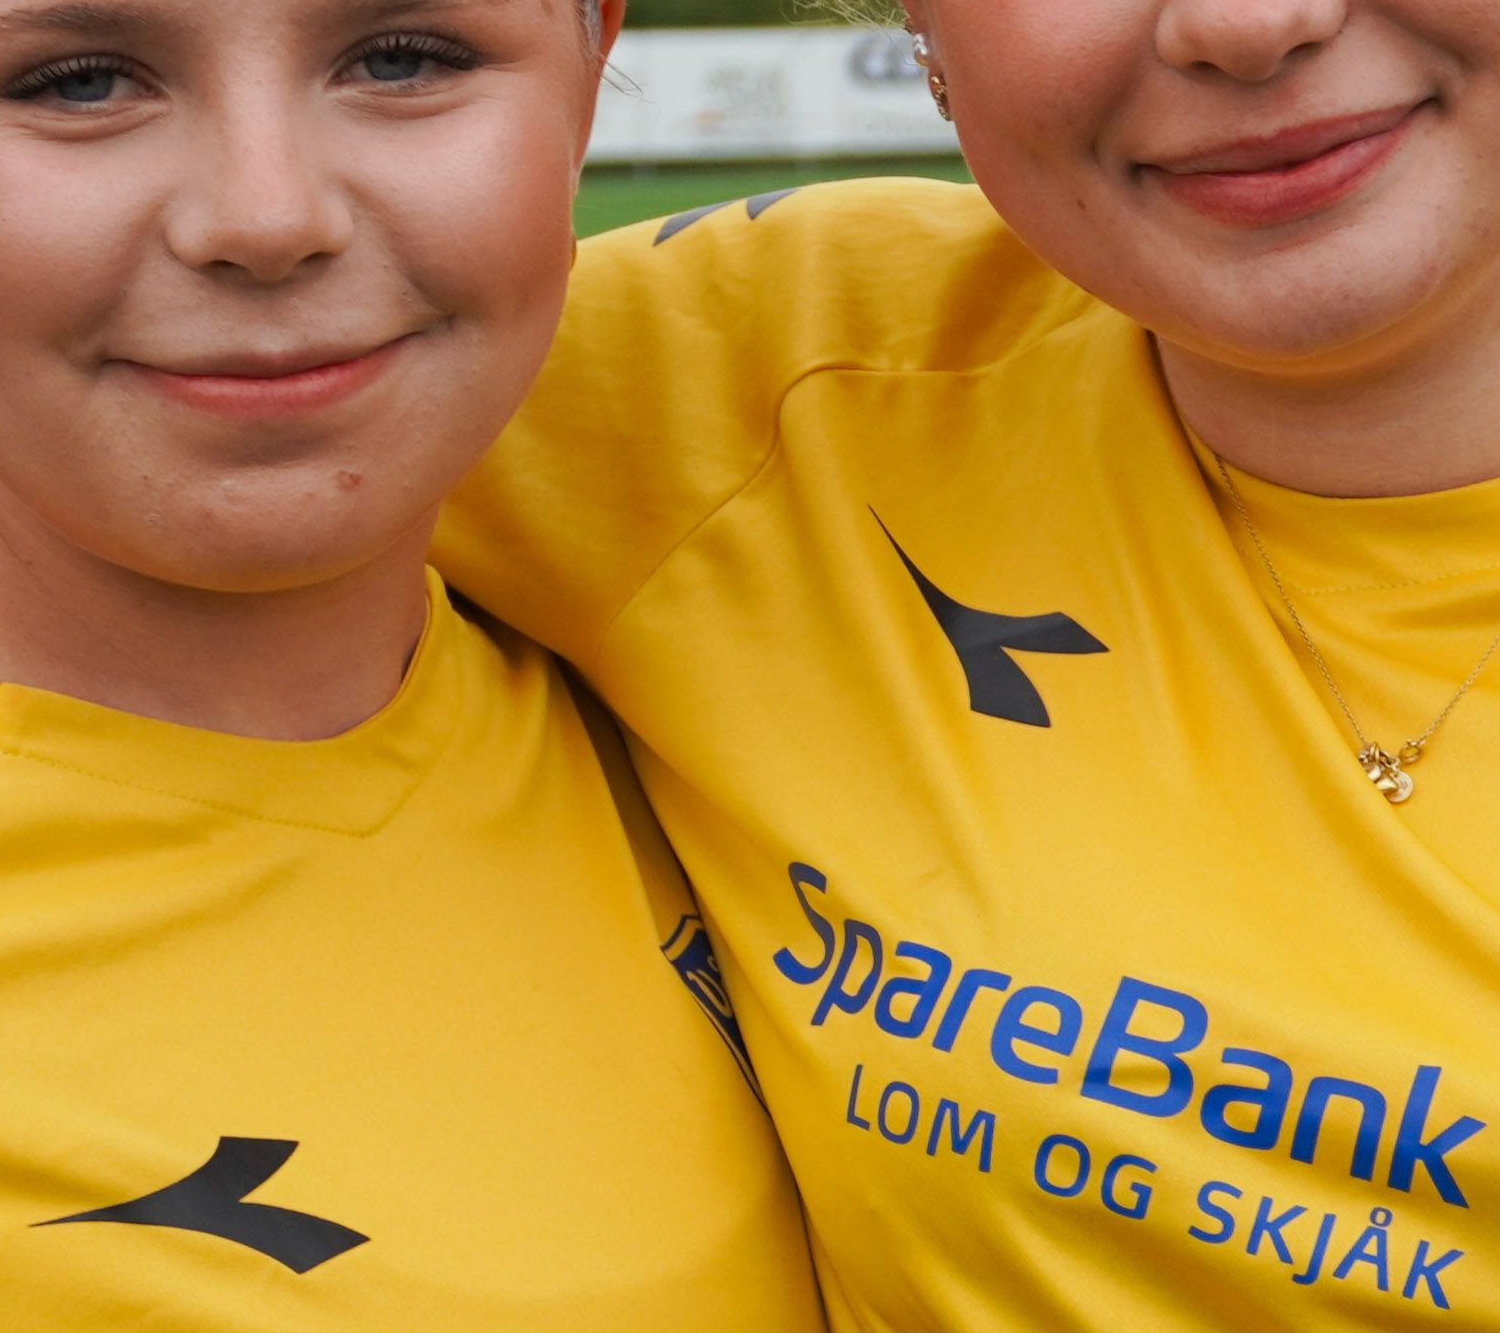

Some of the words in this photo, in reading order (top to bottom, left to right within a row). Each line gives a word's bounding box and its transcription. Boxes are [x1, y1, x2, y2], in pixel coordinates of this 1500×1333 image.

[772, 862, 1486, 1209] SpareBank
[847, 1064, 997, 1174] LOM
[1033, 1133, 1158, 1221] OG
[1187, 1207, 1465, 1312] SKJÅK
